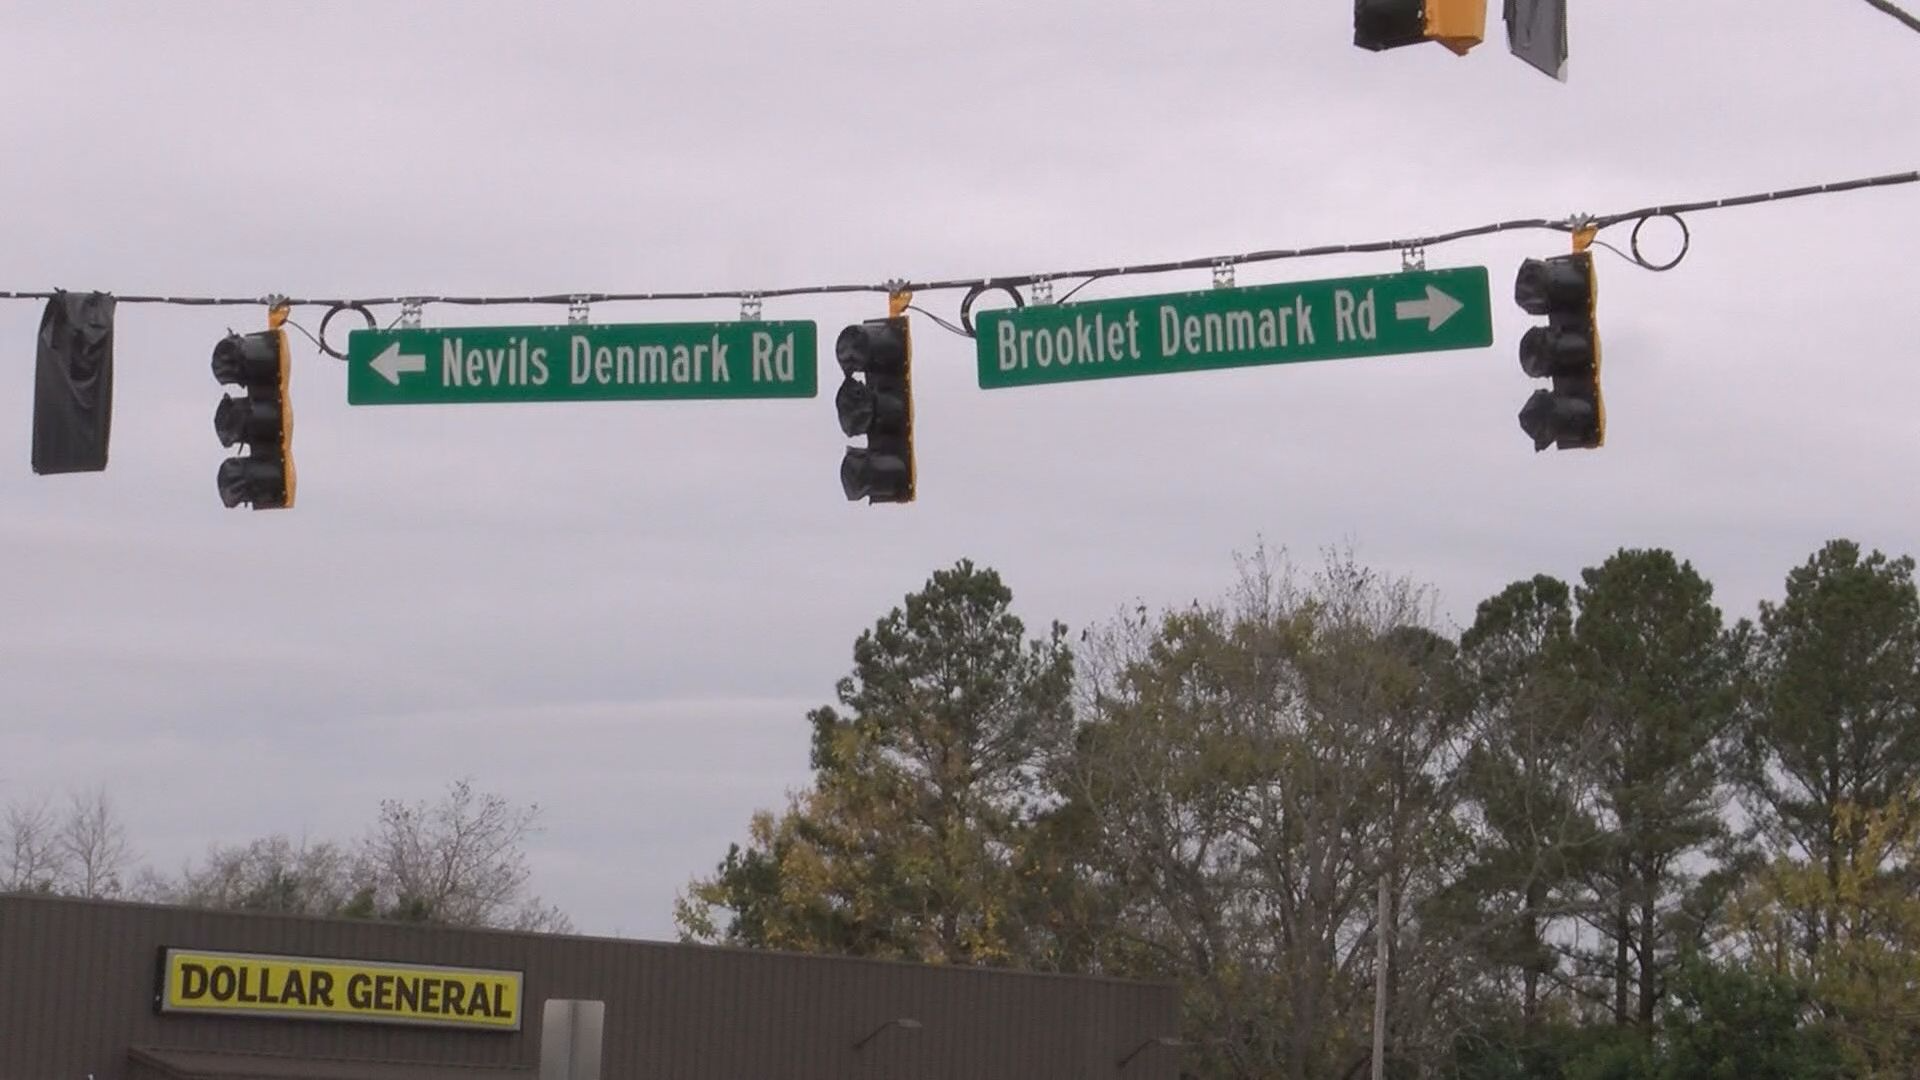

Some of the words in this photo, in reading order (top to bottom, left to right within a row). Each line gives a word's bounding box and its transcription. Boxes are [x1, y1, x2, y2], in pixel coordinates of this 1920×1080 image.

[997, 308, 1141, 371] Brooklet
[1160, 294, 1315, 357] Denmark
[1335, 287, 1377, 343] Rd
[442, 336, 549, 386] Nevils
[570, 333, 730, 384] Denmark
[752, 331, 795, 382] Rd
[181, 963, 334, 1007] DOLLAR
[347, 972, 512, 1018] GENERAL
